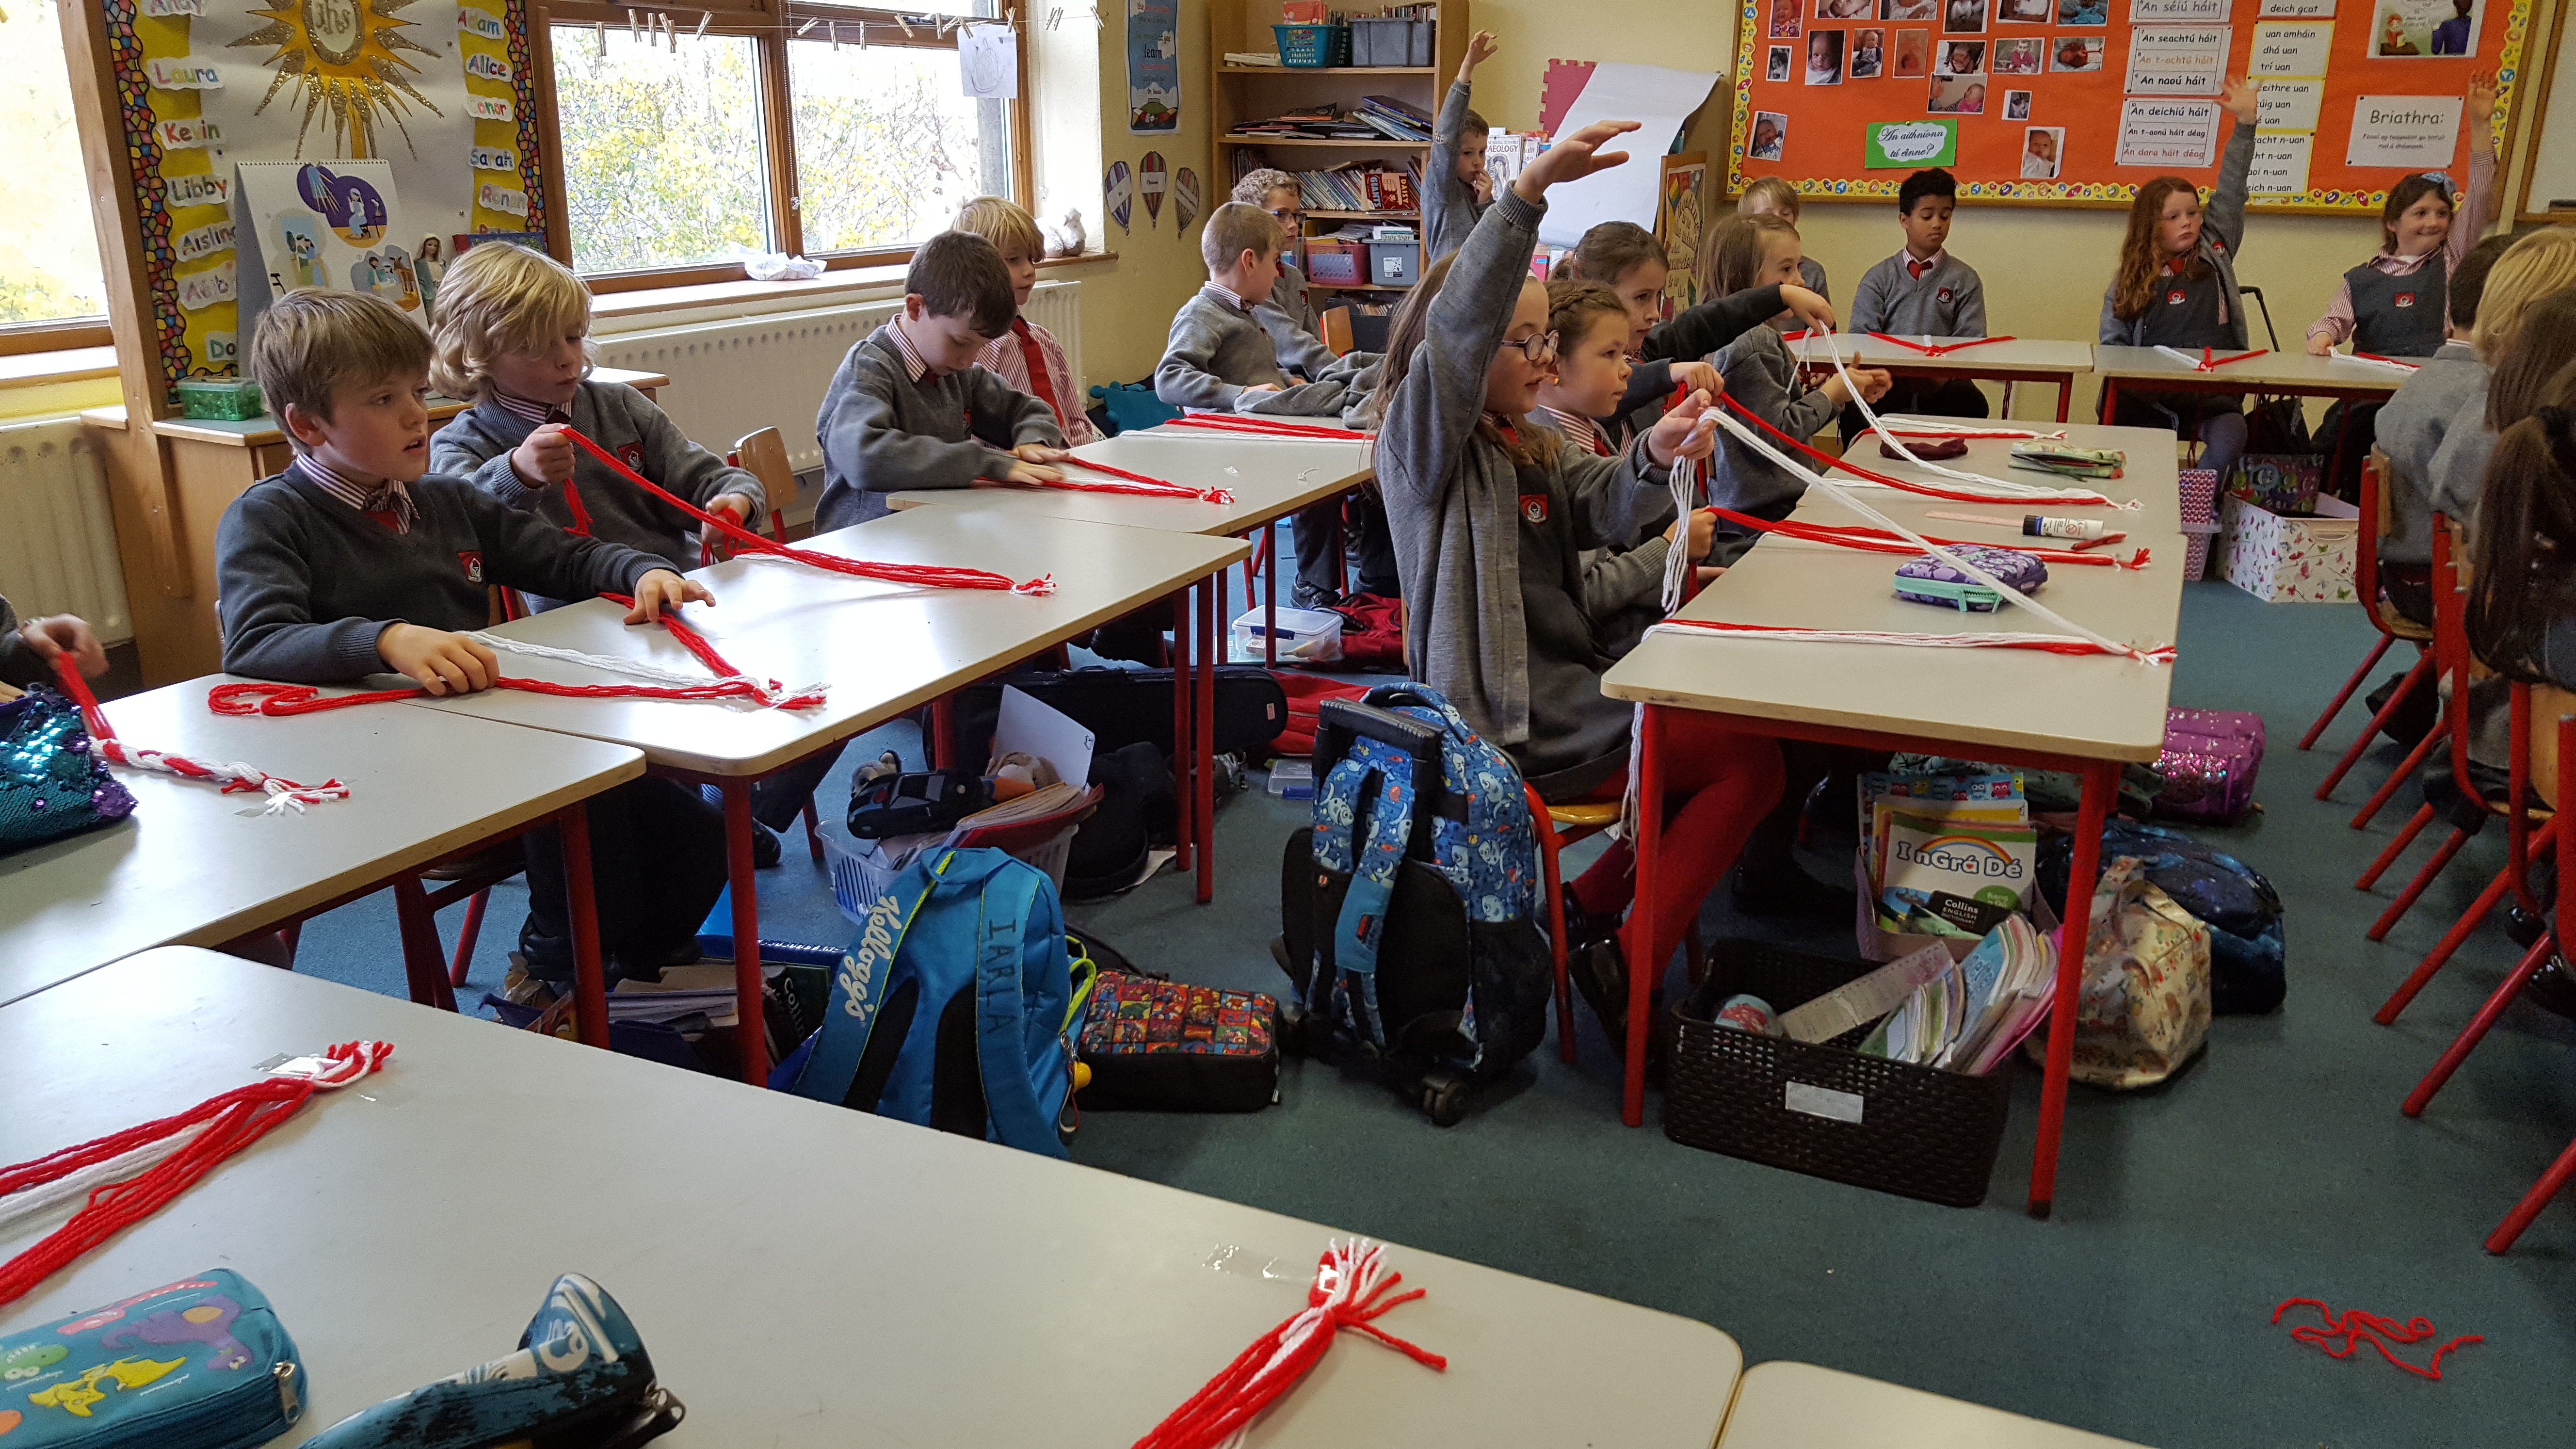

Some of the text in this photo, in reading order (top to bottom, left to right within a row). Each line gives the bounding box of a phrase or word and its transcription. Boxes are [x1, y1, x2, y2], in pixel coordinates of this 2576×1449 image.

[2141, 2, 2157, 12] An
[2193, 2, 2217, 12] háit
[2270, 4, 2318, 15] deich gcat
[458, 9, 500, 35] Adam
[2158, 34, 2195, 43] seachtú
[2198, 34, 2217, 43] háit
[2284, 29, 2316, 38] amháin
[1143, 43, 1162, 59] learn
[2263, 46, 2280, 54] dhá
[468, 54, 506, 77] Alice
[2156, 56, 2190, 64] t-ochtú
[2261, 62, 2273, 71] trí
[154, 63, 219, 83] Laura
[2141, 76, 2154, 85] An
[2158, 76, 2181, 85] naoú
[2186, 76, 2206, 85] háit
[468, 97, 507, 116] Conor
[2149, 106, 2184, 116] deichiú
[2189, 107, 2209, 116] háit
[2256, 115, 2263, 124] é
[2370, 110, 2444, 125] Briathra:
[164, 119, 220, 144] Kevin
[1877, 128, 1899, 142] An
[2187, 129, 2206, 138] déag
[2254, 136, 2277, 144] acht
[470, 148, 513, 167] Sarah
[2162, 148, 2179, 157] háit
[2183, 149, 2205, 160] déag
[172, 176, 227, 201] Libby
[1370, 177, 1382, 207] GIANTS
[1401, 179, 1409, 204] DAISY
[2247, 183, 2264, 192] eich
[482, 185, 526, 210] Ronan
[211, 339, 236, 358] Do
[1897, 840, 2023, 878] I nGrá Dé
[1943, 907, 1978, 919] ENGLISH
[1945, 899, 1979, 915] Collins
[839, 896, 902, 1021] Kellogg's
[986, 919, 1018, 1035] IARLA
